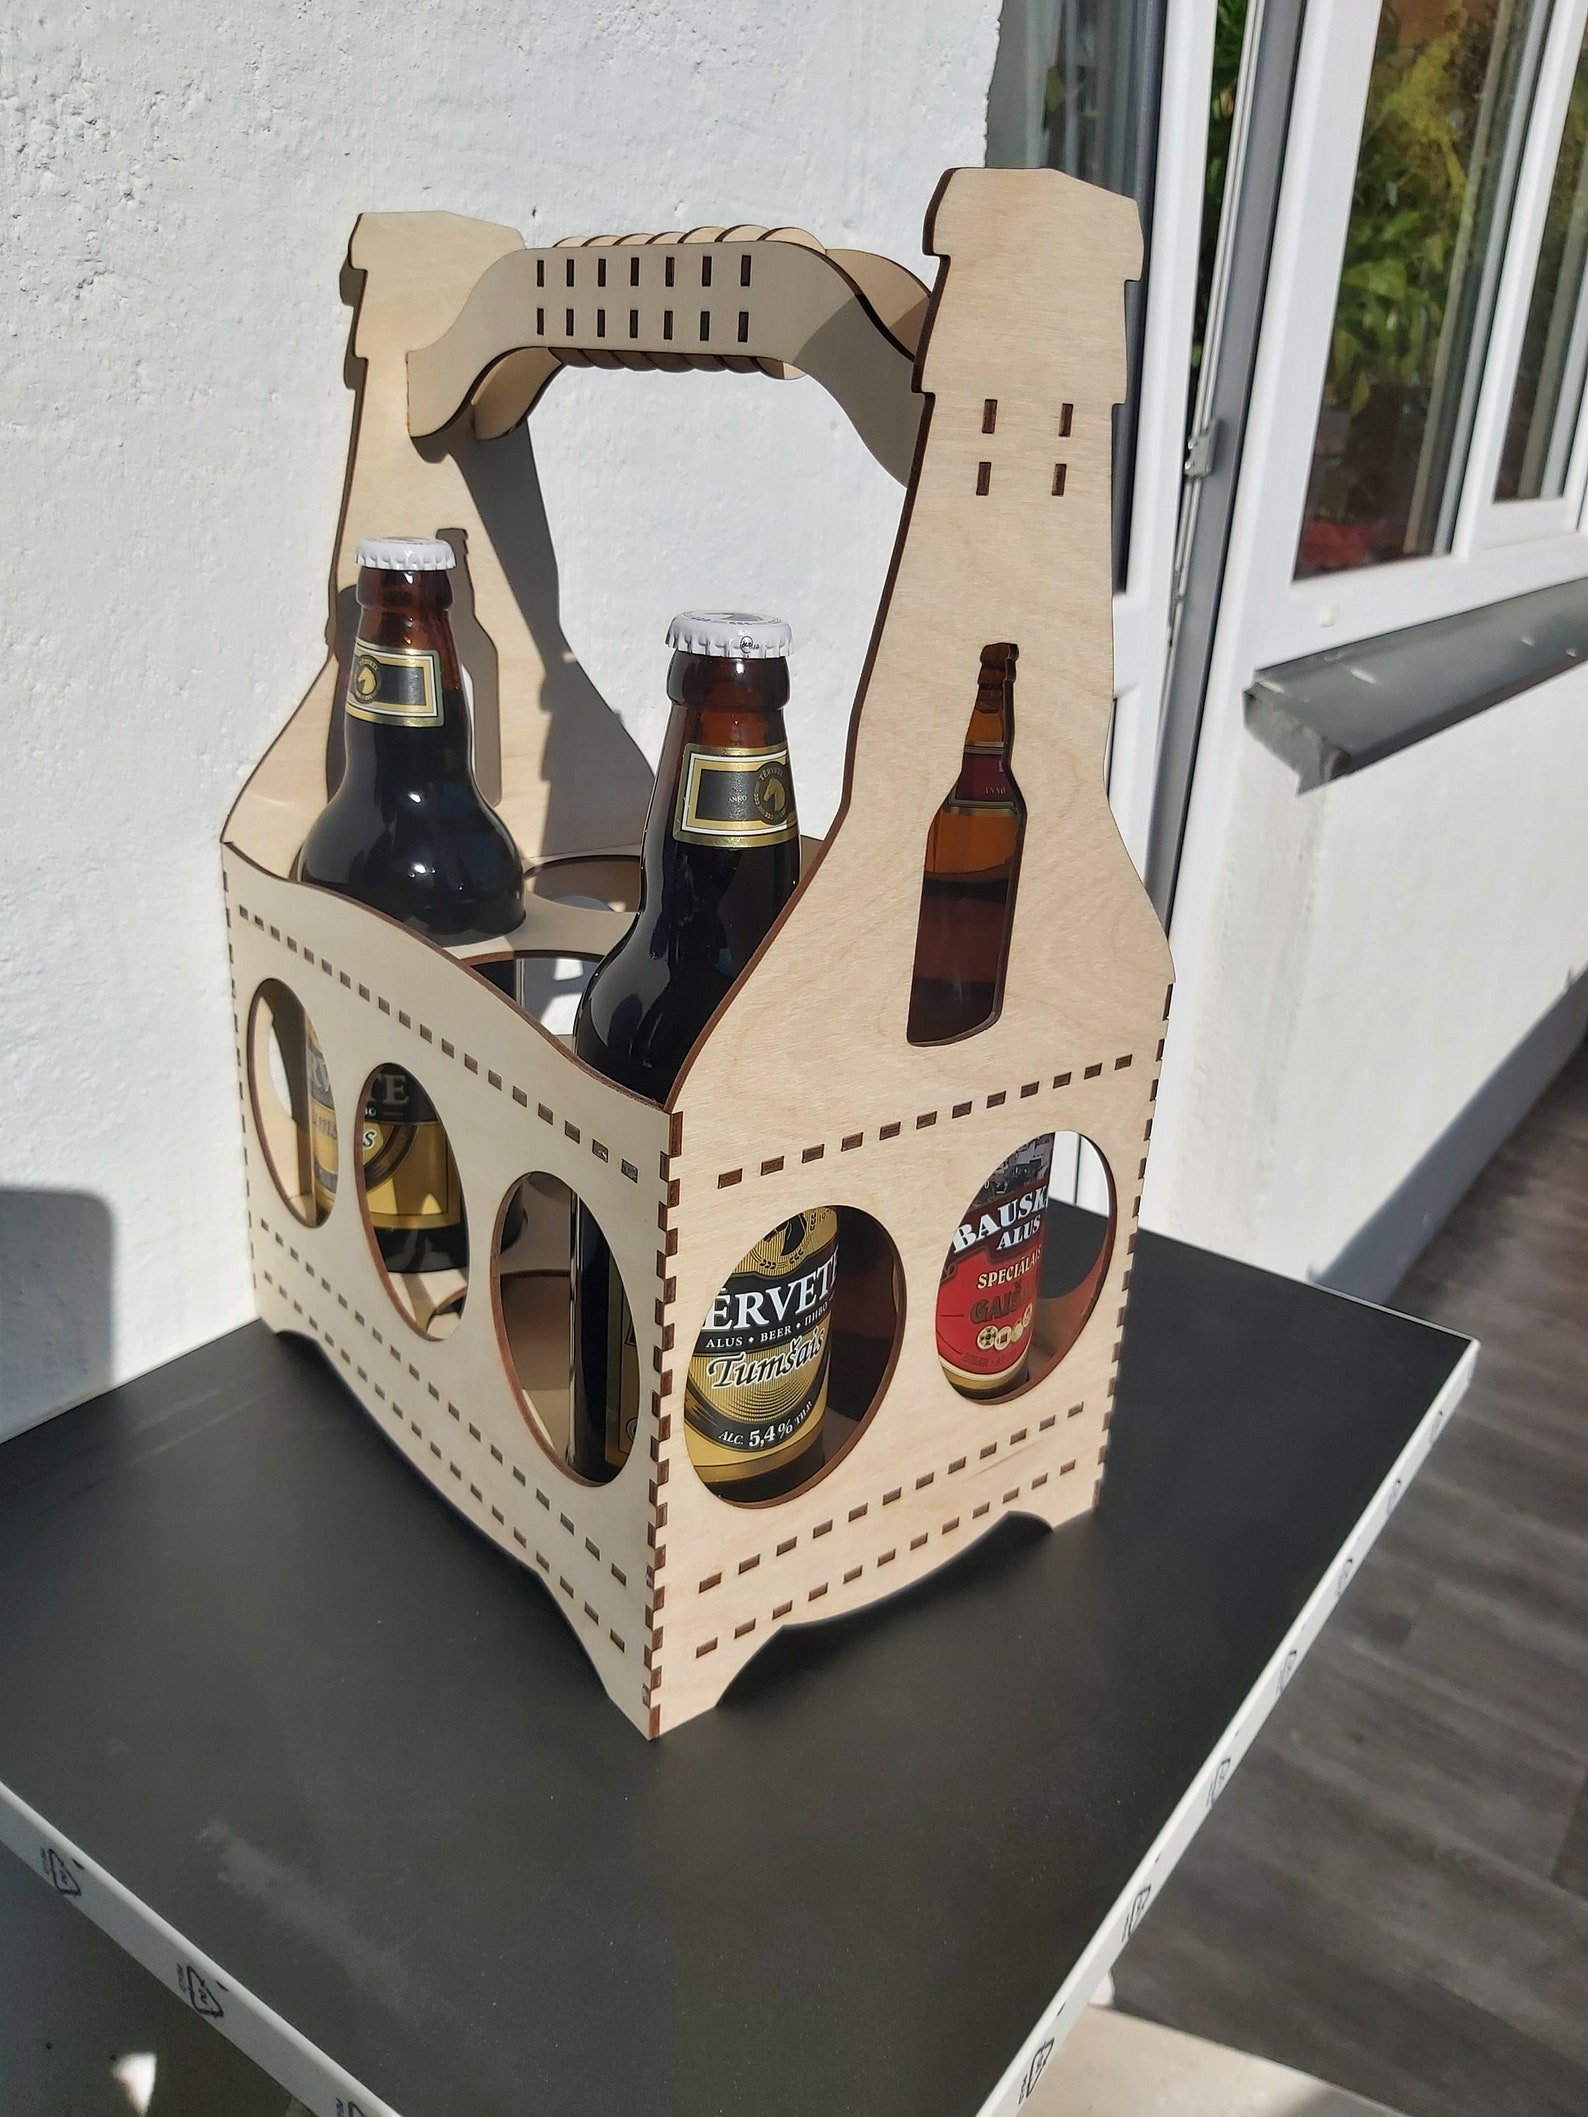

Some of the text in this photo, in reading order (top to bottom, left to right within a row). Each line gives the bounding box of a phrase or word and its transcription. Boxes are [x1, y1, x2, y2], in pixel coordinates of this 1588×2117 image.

[953, 1185, 1048, 1254] BAUSK
[996, 1214, 1041, 1250] ALUS
[804, 1301, 828, 1326] ПИВО
[705, 1325, 792, 1349] ALUS BEER
[706, 1325, 825, 1389] Tumšais
[719, 1431, 744, 1445] ALC.
